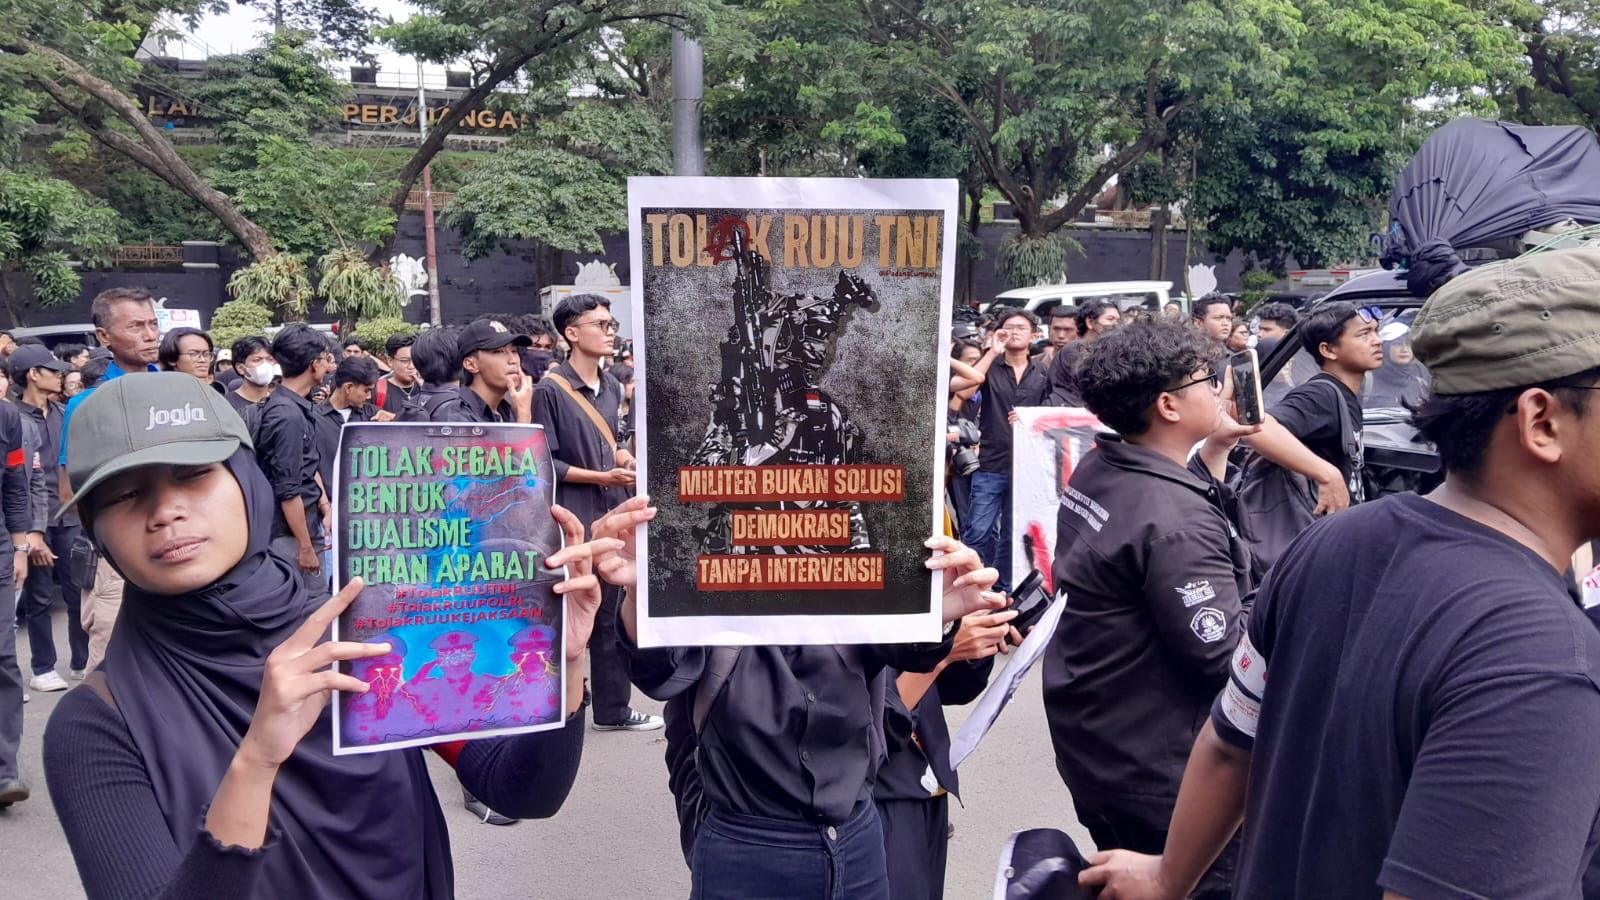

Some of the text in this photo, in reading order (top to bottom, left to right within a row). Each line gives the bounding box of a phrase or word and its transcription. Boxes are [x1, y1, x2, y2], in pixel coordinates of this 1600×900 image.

[646, 213, 938, 269] TOLAK RUU TNI
[145, 402, 208, 431] jogja
[350, 446, 537, 478] TOLAK SEGALA
[680, 468, 902, 496] MILITER BUKAN SOLUSI
[349, 481, 447, 513] BENTUK
[349, 518, 472, 550] DUALISME
[733, 512, 849, 540] DEMOKRASI
[350, 550, 538, 586] PERAN APARAT
[699, 556, 883, 584] TANPA INTERVENSI!
[386, 596, 524, 614] #TolakRUUPOLRI
[395, 583, 517, 600] #TolakRUUTNI
[354, 607, 544, 631] #TolakRUUKEJAKSAAN
